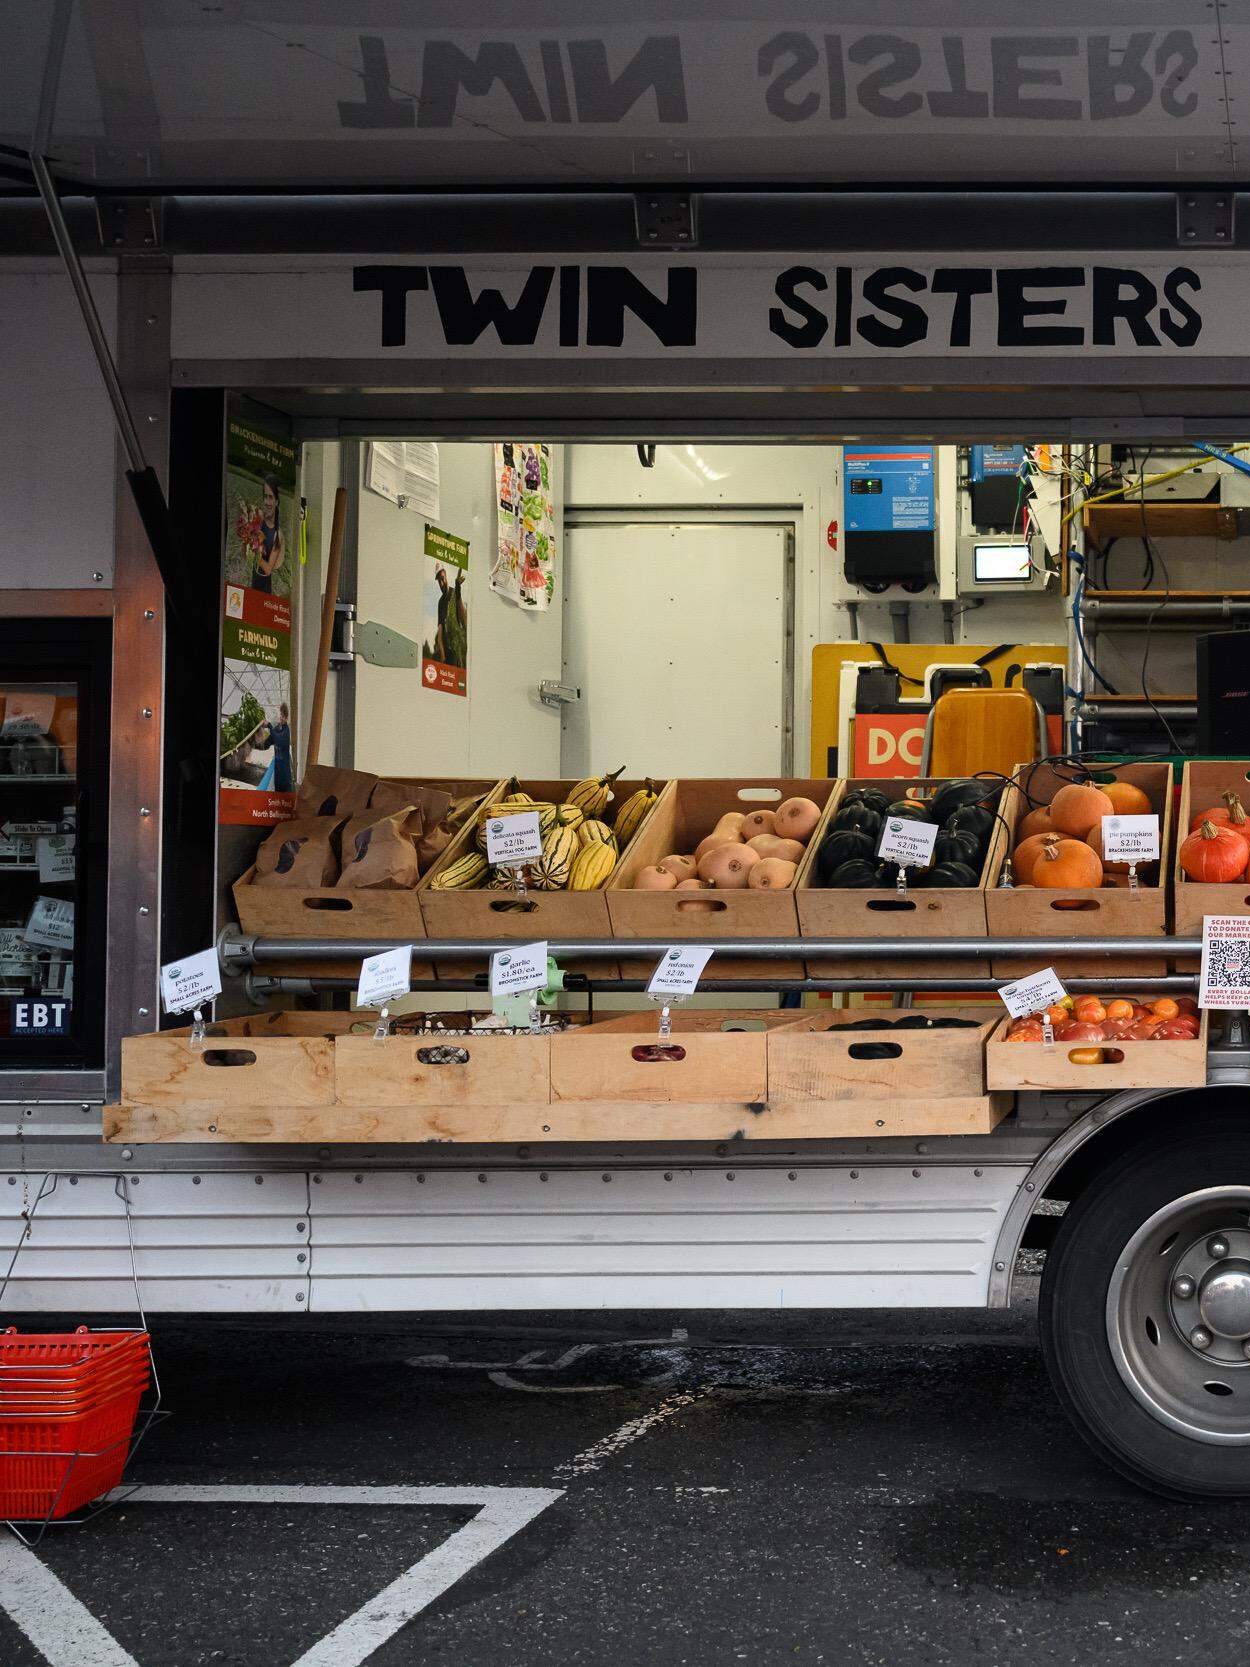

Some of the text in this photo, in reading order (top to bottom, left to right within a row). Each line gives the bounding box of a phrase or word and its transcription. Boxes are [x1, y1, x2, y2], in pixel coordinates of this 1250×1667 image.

[353, 265, 697, 347] TWIN
[769, 265, 1202, 348] SISTERS
[239, 628, 279, 650] FARMWILD
[252, 808, 269, 818] North
[492, 828, 536, 840] delicata squash
[1119, 830, 1153, 838] pumpkins
[503, 838, 525, 848] $2/lb
[909, 836, 929, 844] squash
[1120, 839, 1142, 847] $2/lb
[896, 841, 918, 851] $2/lb
[509, 959, 531, 970] garlic
[501, 966, 536, 979] $1.80/ea
[665, 969, 685, 977] $2/lb
[175, 971, 204, 986] potatoes
[498, 975, 529, 986] BROOMSTICK
[178, 981, 200, 993] $2/lb
[170, 996, 185, 1004] SMALL
[15, 1003, 66, 1028] EBT
